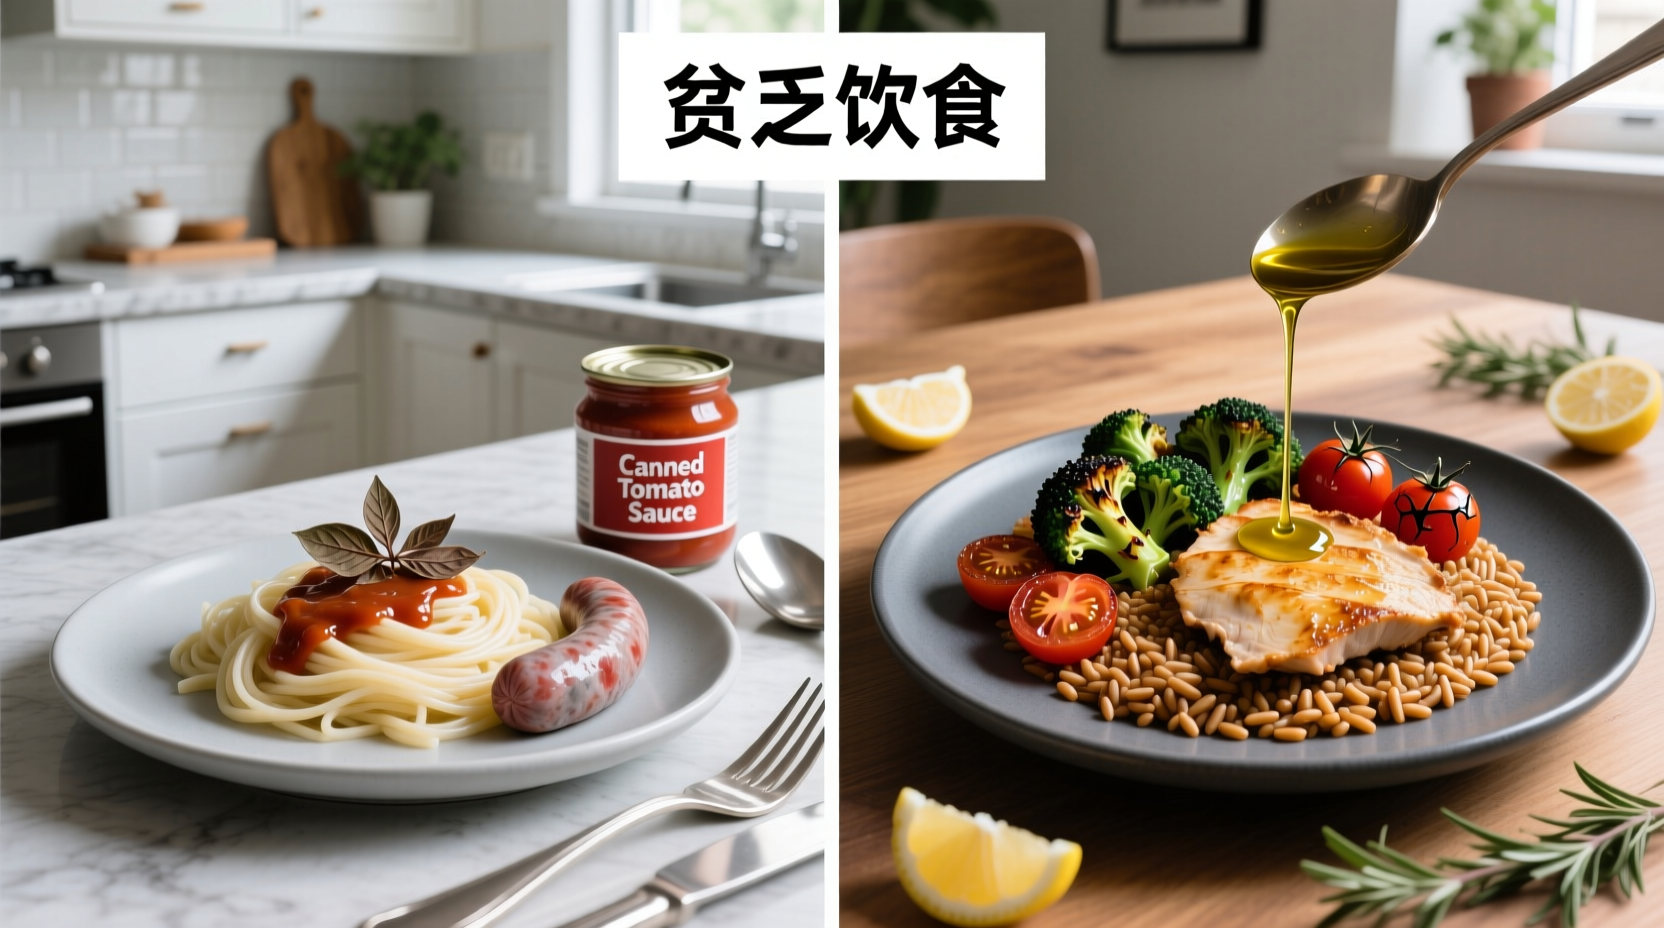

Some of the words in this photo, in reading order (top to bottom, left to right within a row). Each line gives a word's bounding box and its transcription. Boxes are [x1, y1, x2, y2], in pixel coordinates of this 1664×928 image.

[619, 451, 705, 477] Canned
[617, 478, 705, 499] Tomato
[628, 501, 697, 523] Sauce
